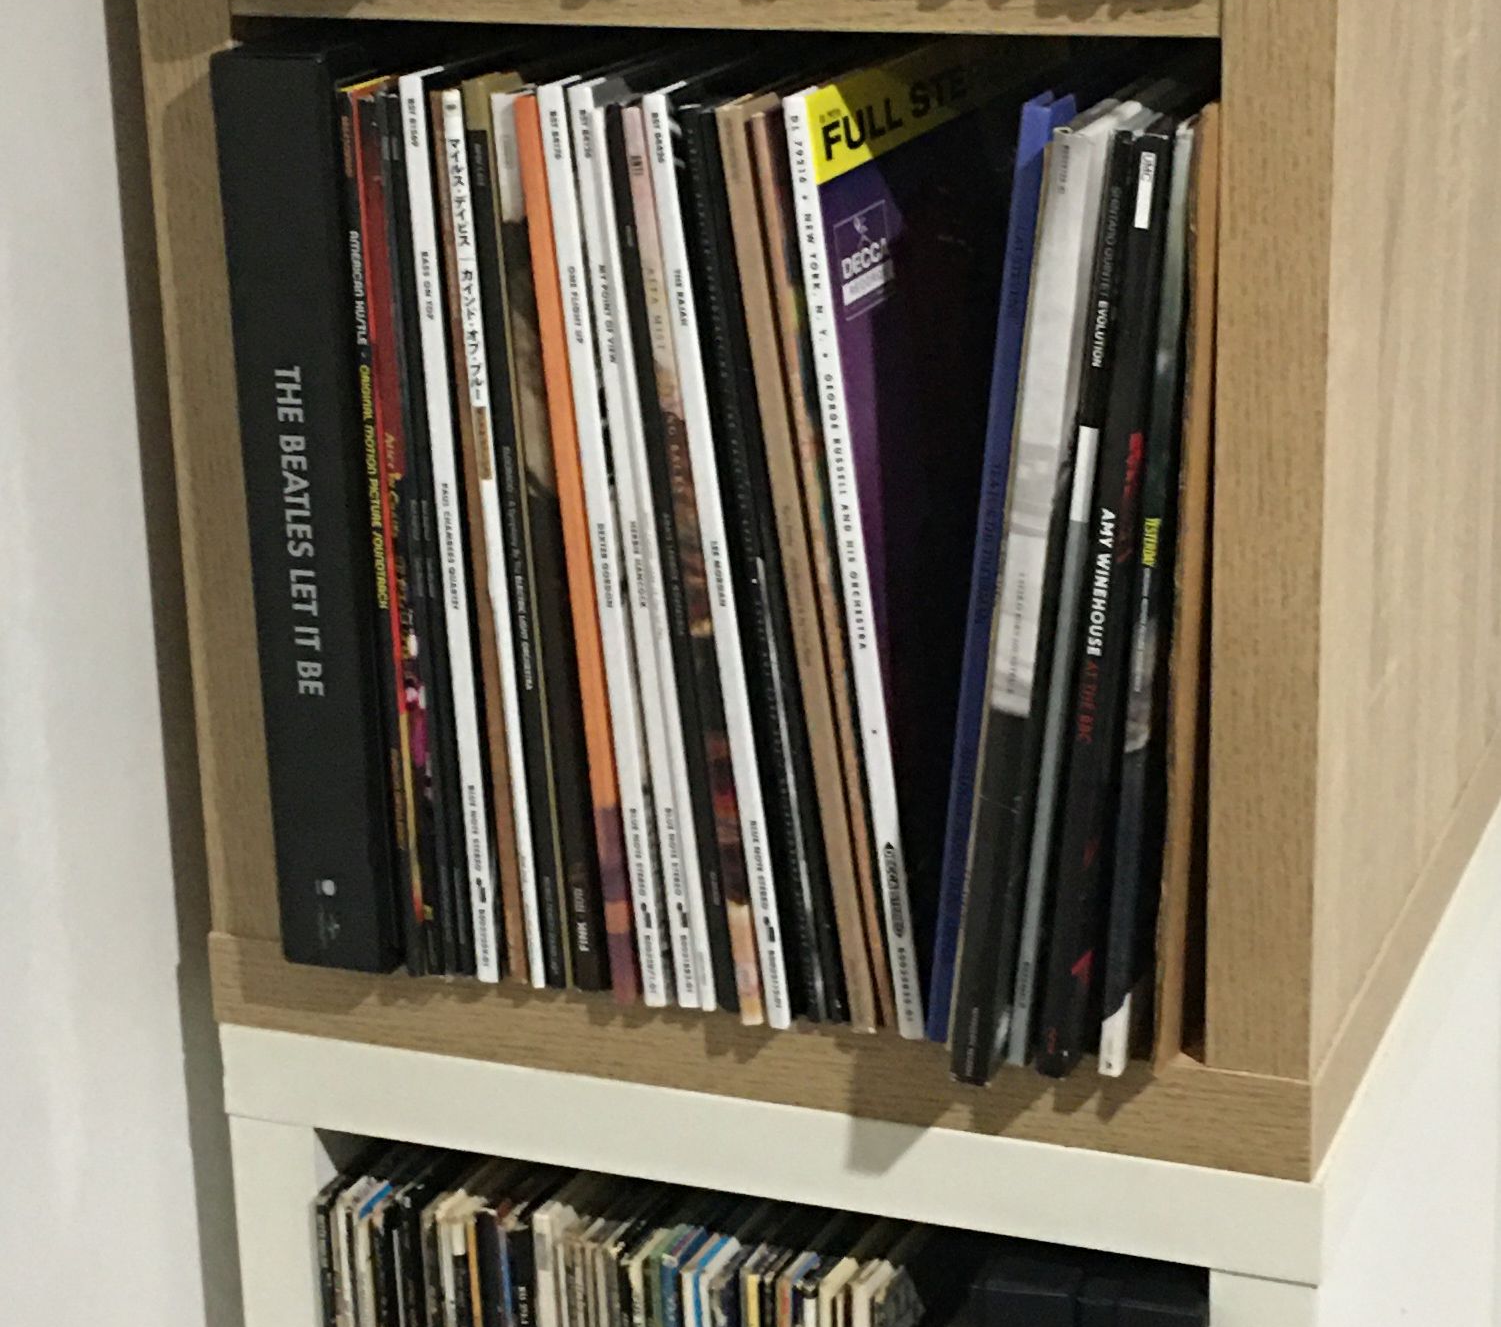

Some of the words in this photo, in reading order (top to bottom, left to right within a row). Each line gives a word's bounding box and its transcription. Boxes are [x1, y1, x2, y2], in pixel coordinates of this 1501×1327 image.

[821, 97, 903, 162] FULL
[803, 214, 814, 244] NEW
[1106, 186, 1123, 244] SHINTARO
[349, 230, 365, 298] AMERICAN
[422, 251, 432, 277] BASS
[568, 266, 577, 288] ONE
[598, 265, 606, 281] MY
[673, 269, 682, 288] THE
[1100, 247, 1114, 296] QUINTET
[423, 281, 432, 297] ON
[570, 291, 581, 326] FLIGHT
[600, 284, 610, 316] POINT
[425, 301, 434, 320] TOP
[604, 319, 612, 335] OF
[677, 292, 688, 327] RAJAH
[574, 329, 583, 344] UP
[606, 337, 617, 364] VIEW
[1091, 300, 1110, 368] EVOLUTION
[274, 366, 304, 423] THE
[359, 365, 371, 421] ORIGINAL
[824, 374, 840, 430] GEORGE
[363, 425, 375, 475] MOTION
[832, 438, 848, 496] RUSSELL
[278, 434, 315, 557] BEATLES
[368, 477, 382, 527] PICTURE
[441, 482, 450, 508] PAUL
[443, 511, 455, 563] CHAMBERS
[839, 504, 852, 532] AND
[1098, 508, 1116, 547] AMY
[597, 523, 608, 559] DEXTER
[630, 521, 641, 555] HERBIE
[709, 540, 719, 556] LEE
[846, 540, 855, 563] HIS
[1141, 517, 1163, 568] YESTERDAY
[372, 531, 388, 610] SOUNDTRACK
[447, 566, 459, 610] QUARTET
[602, 562, 613, 609] GORDON
[635, 558, 647, 609] HANCOCK
[712, 560, 726, 608] MORGAN
[289, 568, 318, 616] LET
[850, 571, 867, 651] ORCHESTRA
[1086, 553, 1111, 657] WINEHOUSE
[294, 626, 321, 651] IT
[514, 575, 527, 613] ELECTRIC
[522, 641, 533, 690] ORCHESTRA
[296, 660, 325, 697] BE
[1086, 661, 1101, 678] AT
[1082, 685, 1100, 710] THE
